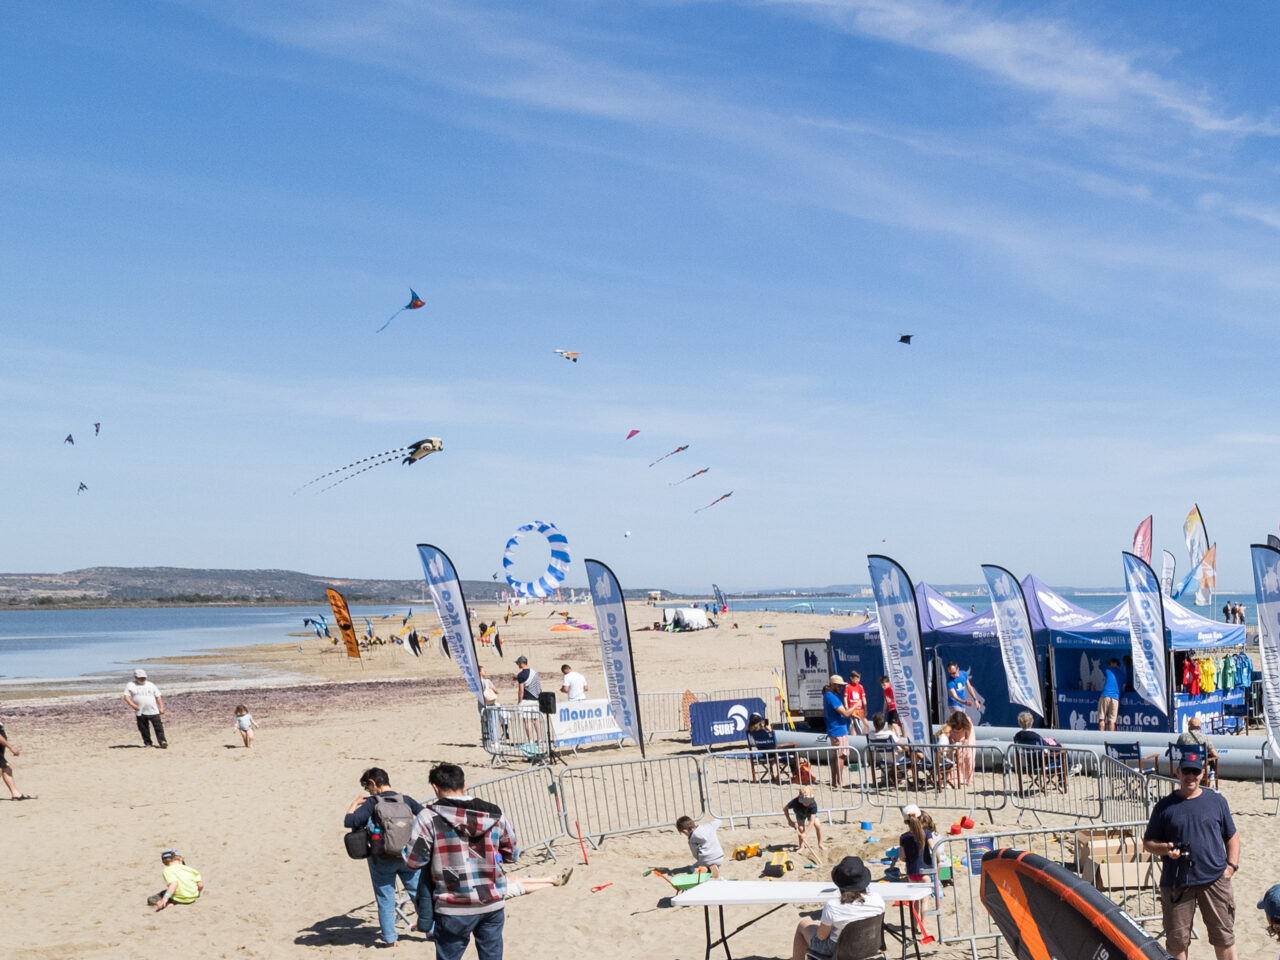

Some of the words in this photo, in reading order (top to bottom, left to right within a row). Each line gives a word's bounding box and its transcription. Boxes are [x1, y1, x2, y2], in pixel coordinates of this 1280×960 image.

[560, 707, 602, 722] Mauna
[1135, 712, 1160, 725] Kea
[713, 722, 735, 736] SURF
